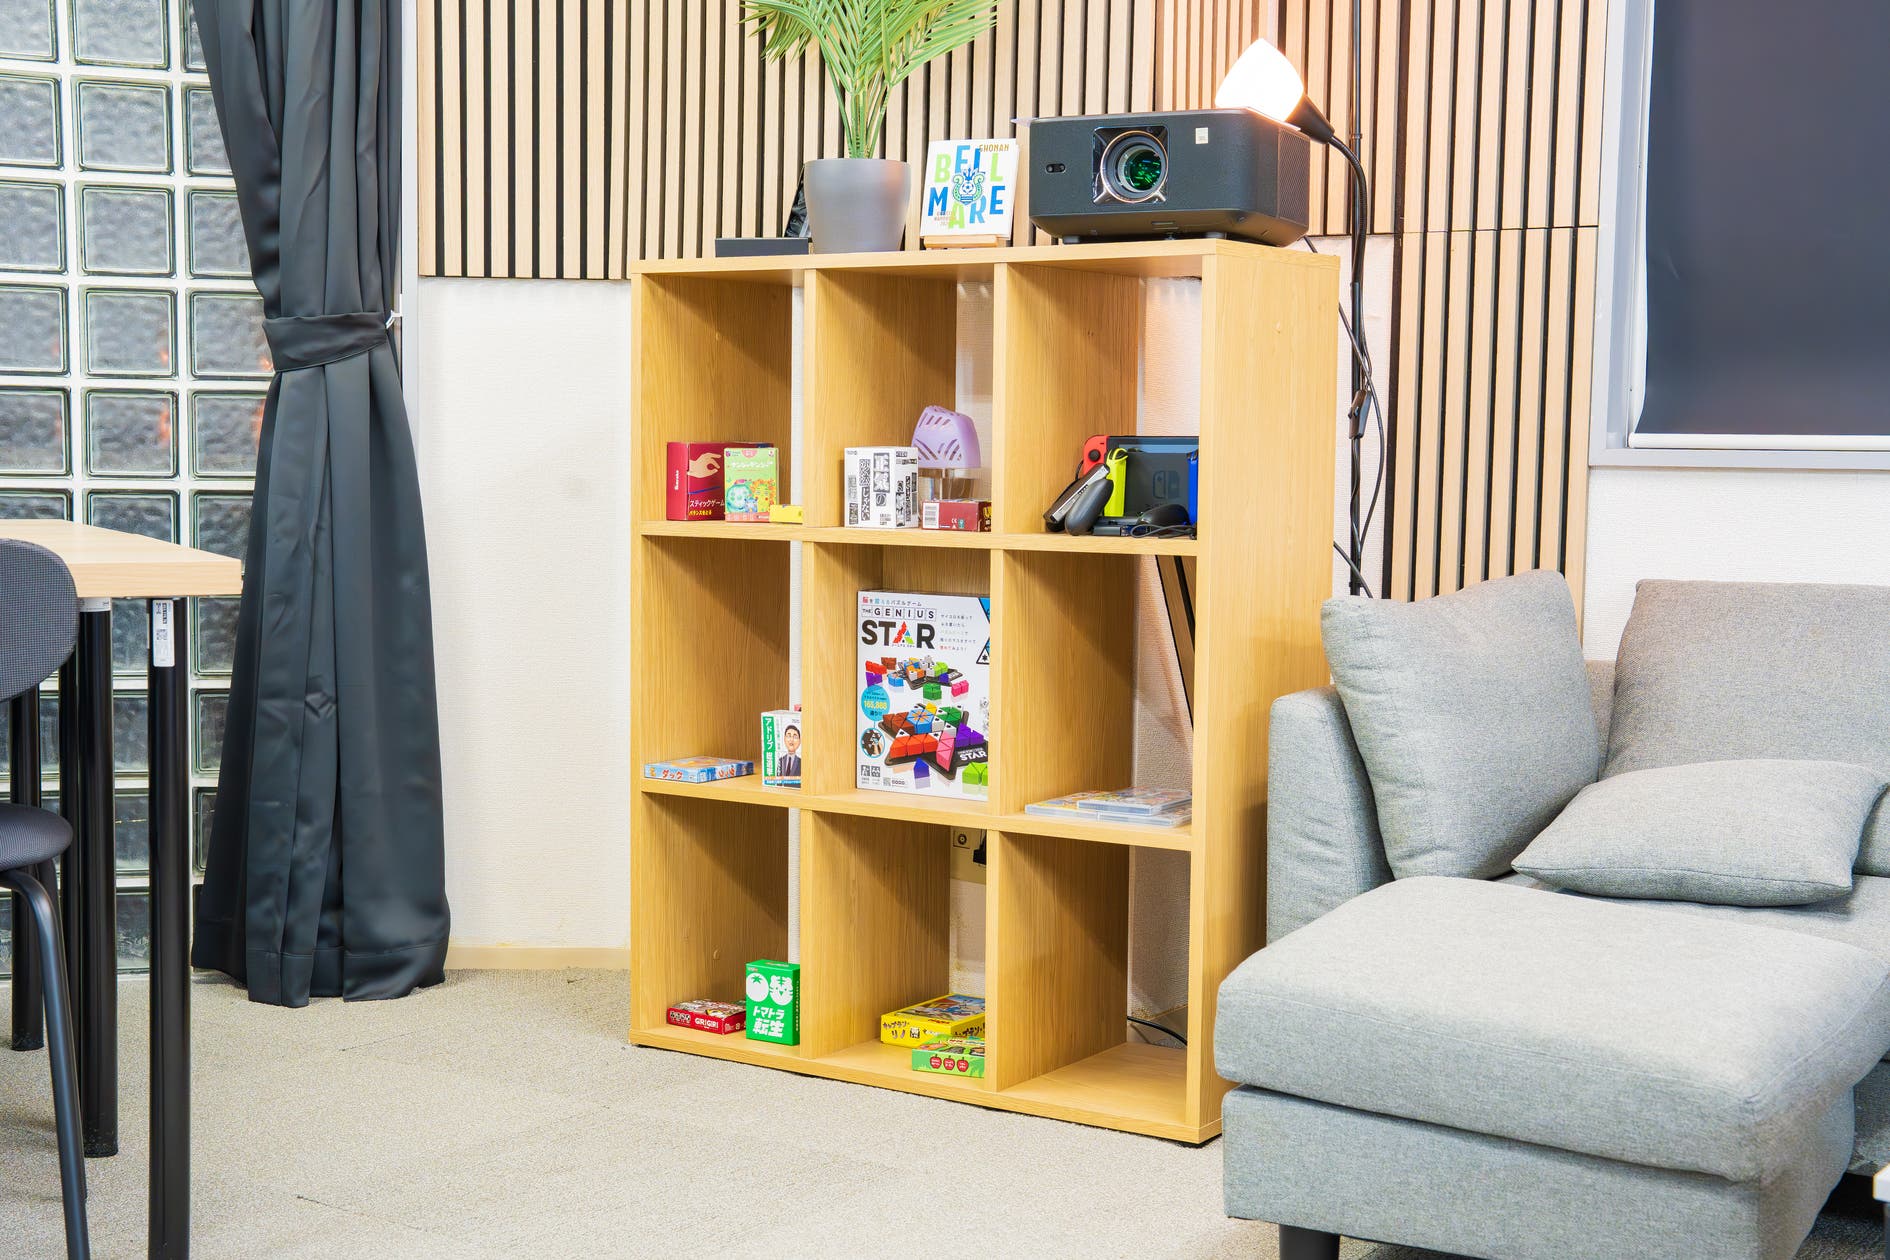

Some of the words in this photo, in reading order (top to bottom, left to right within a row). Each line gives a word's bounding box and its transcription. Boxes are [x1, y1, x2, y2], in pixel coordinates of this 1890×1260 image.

[979, 144, 1010, 153] SHONAN
[928, 186, 1006, 229] MARE
[874, 607, 935, 619] GENIUS
[861, 619, 935, 650] STAR
[960, 751, 987, 761] STAR
[661, 769, 683, 780] ダック
[752, 1005, 785, 1020] トマトラ
[752, 1018, 785, 1038] 転生
